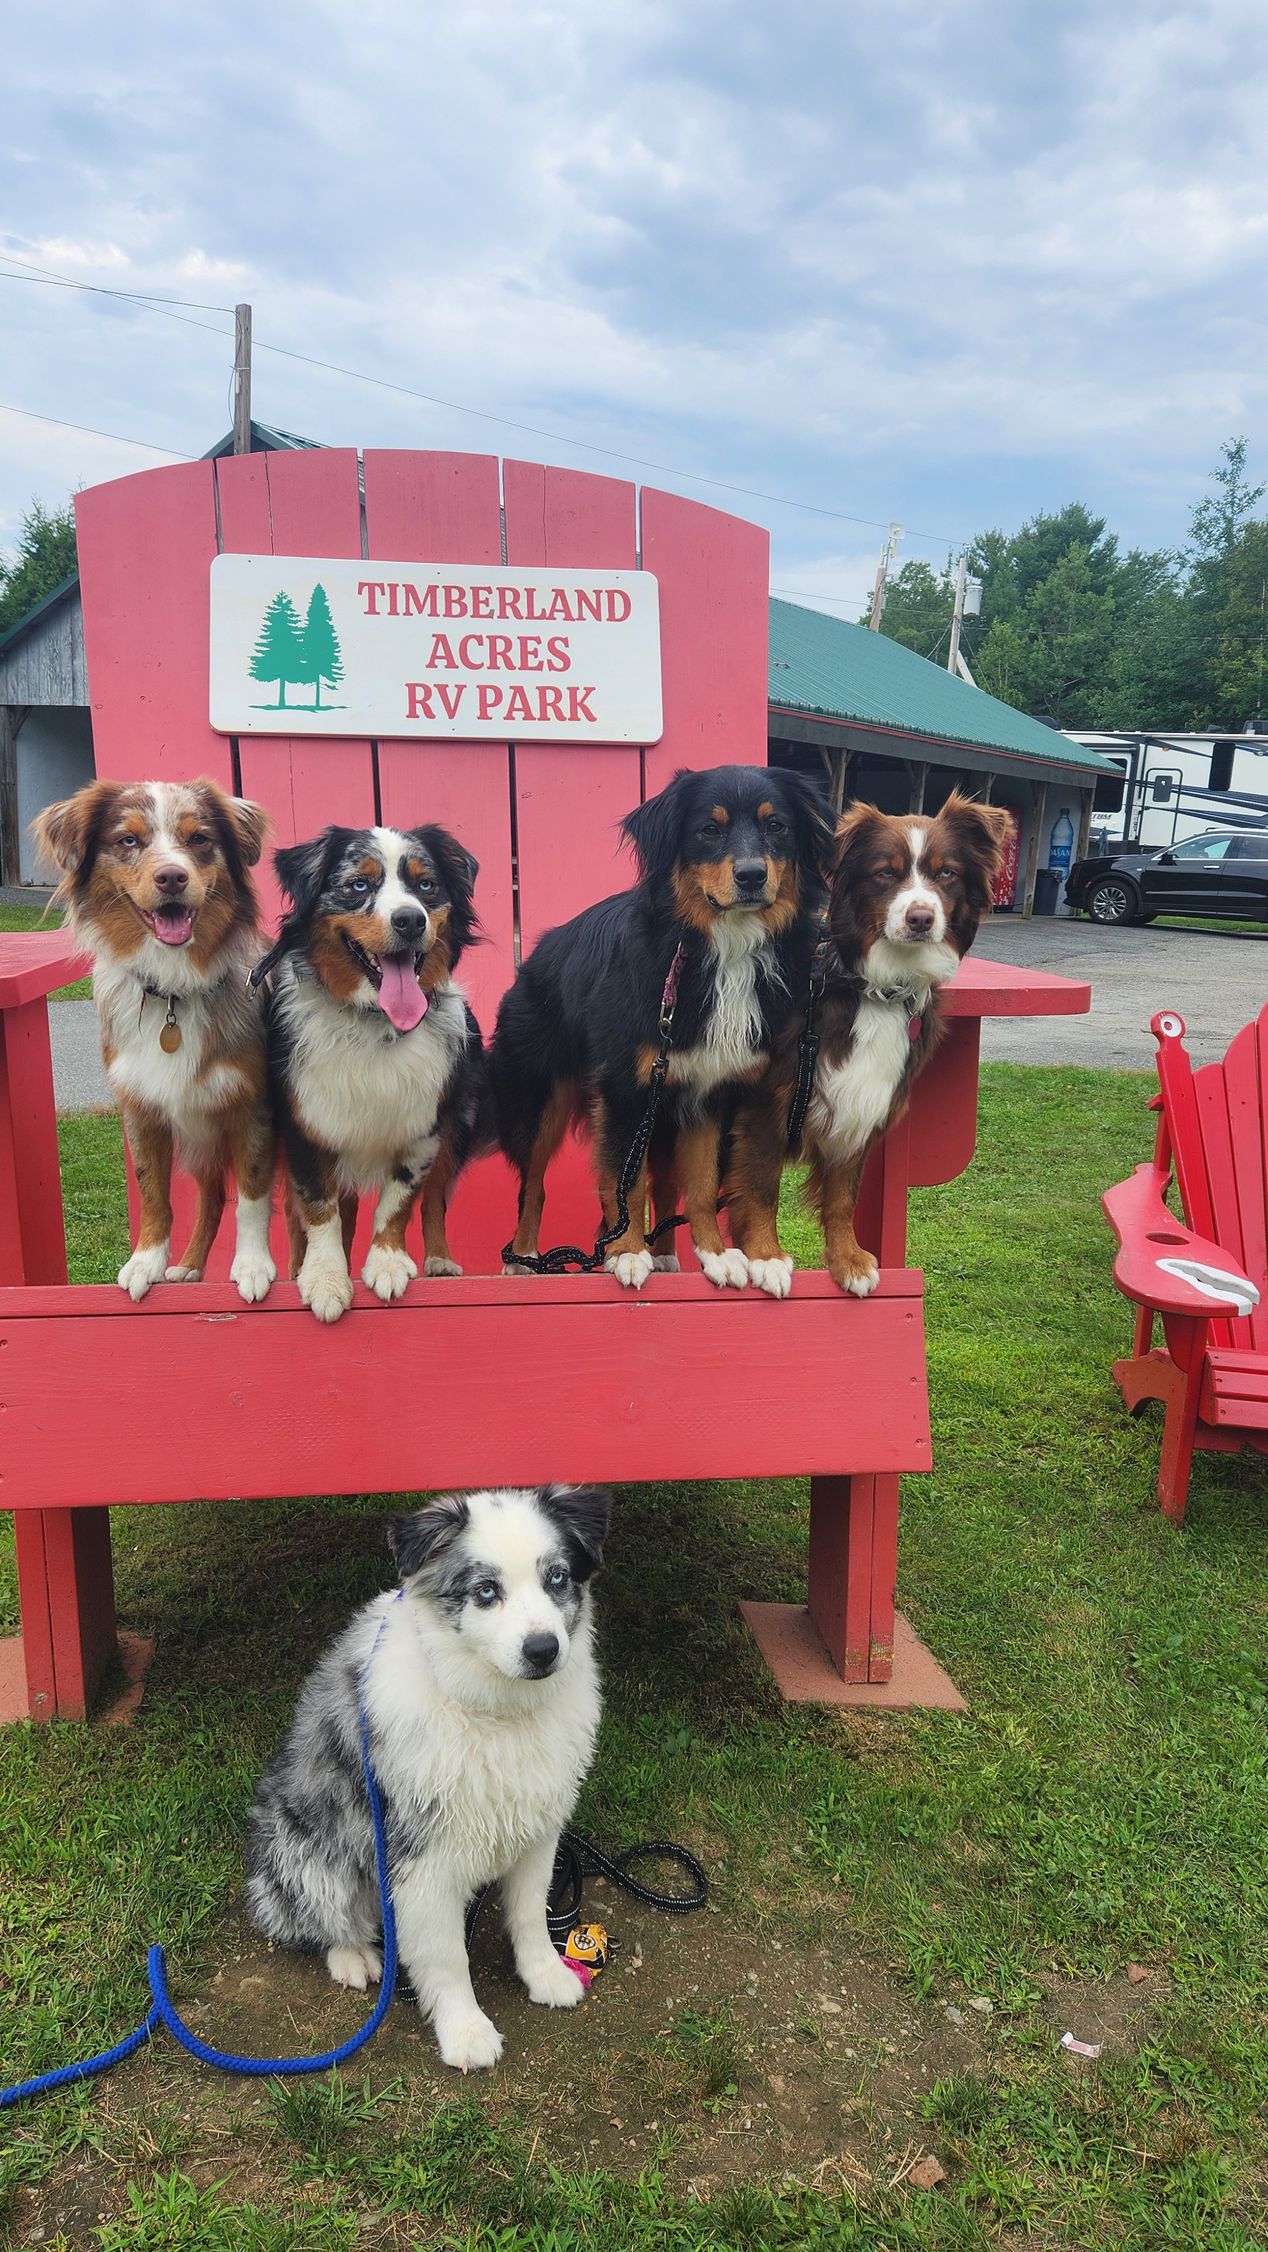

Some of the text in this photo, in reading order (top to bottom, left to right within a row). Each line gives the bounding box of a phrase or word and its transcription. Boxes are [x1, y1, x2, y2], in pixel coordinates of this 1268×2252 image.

[357, 582, 632, 622] TIMBERLAND
[425, 633, 571, 673] ACRES
[404, 683, 597, 722] RV PARK
